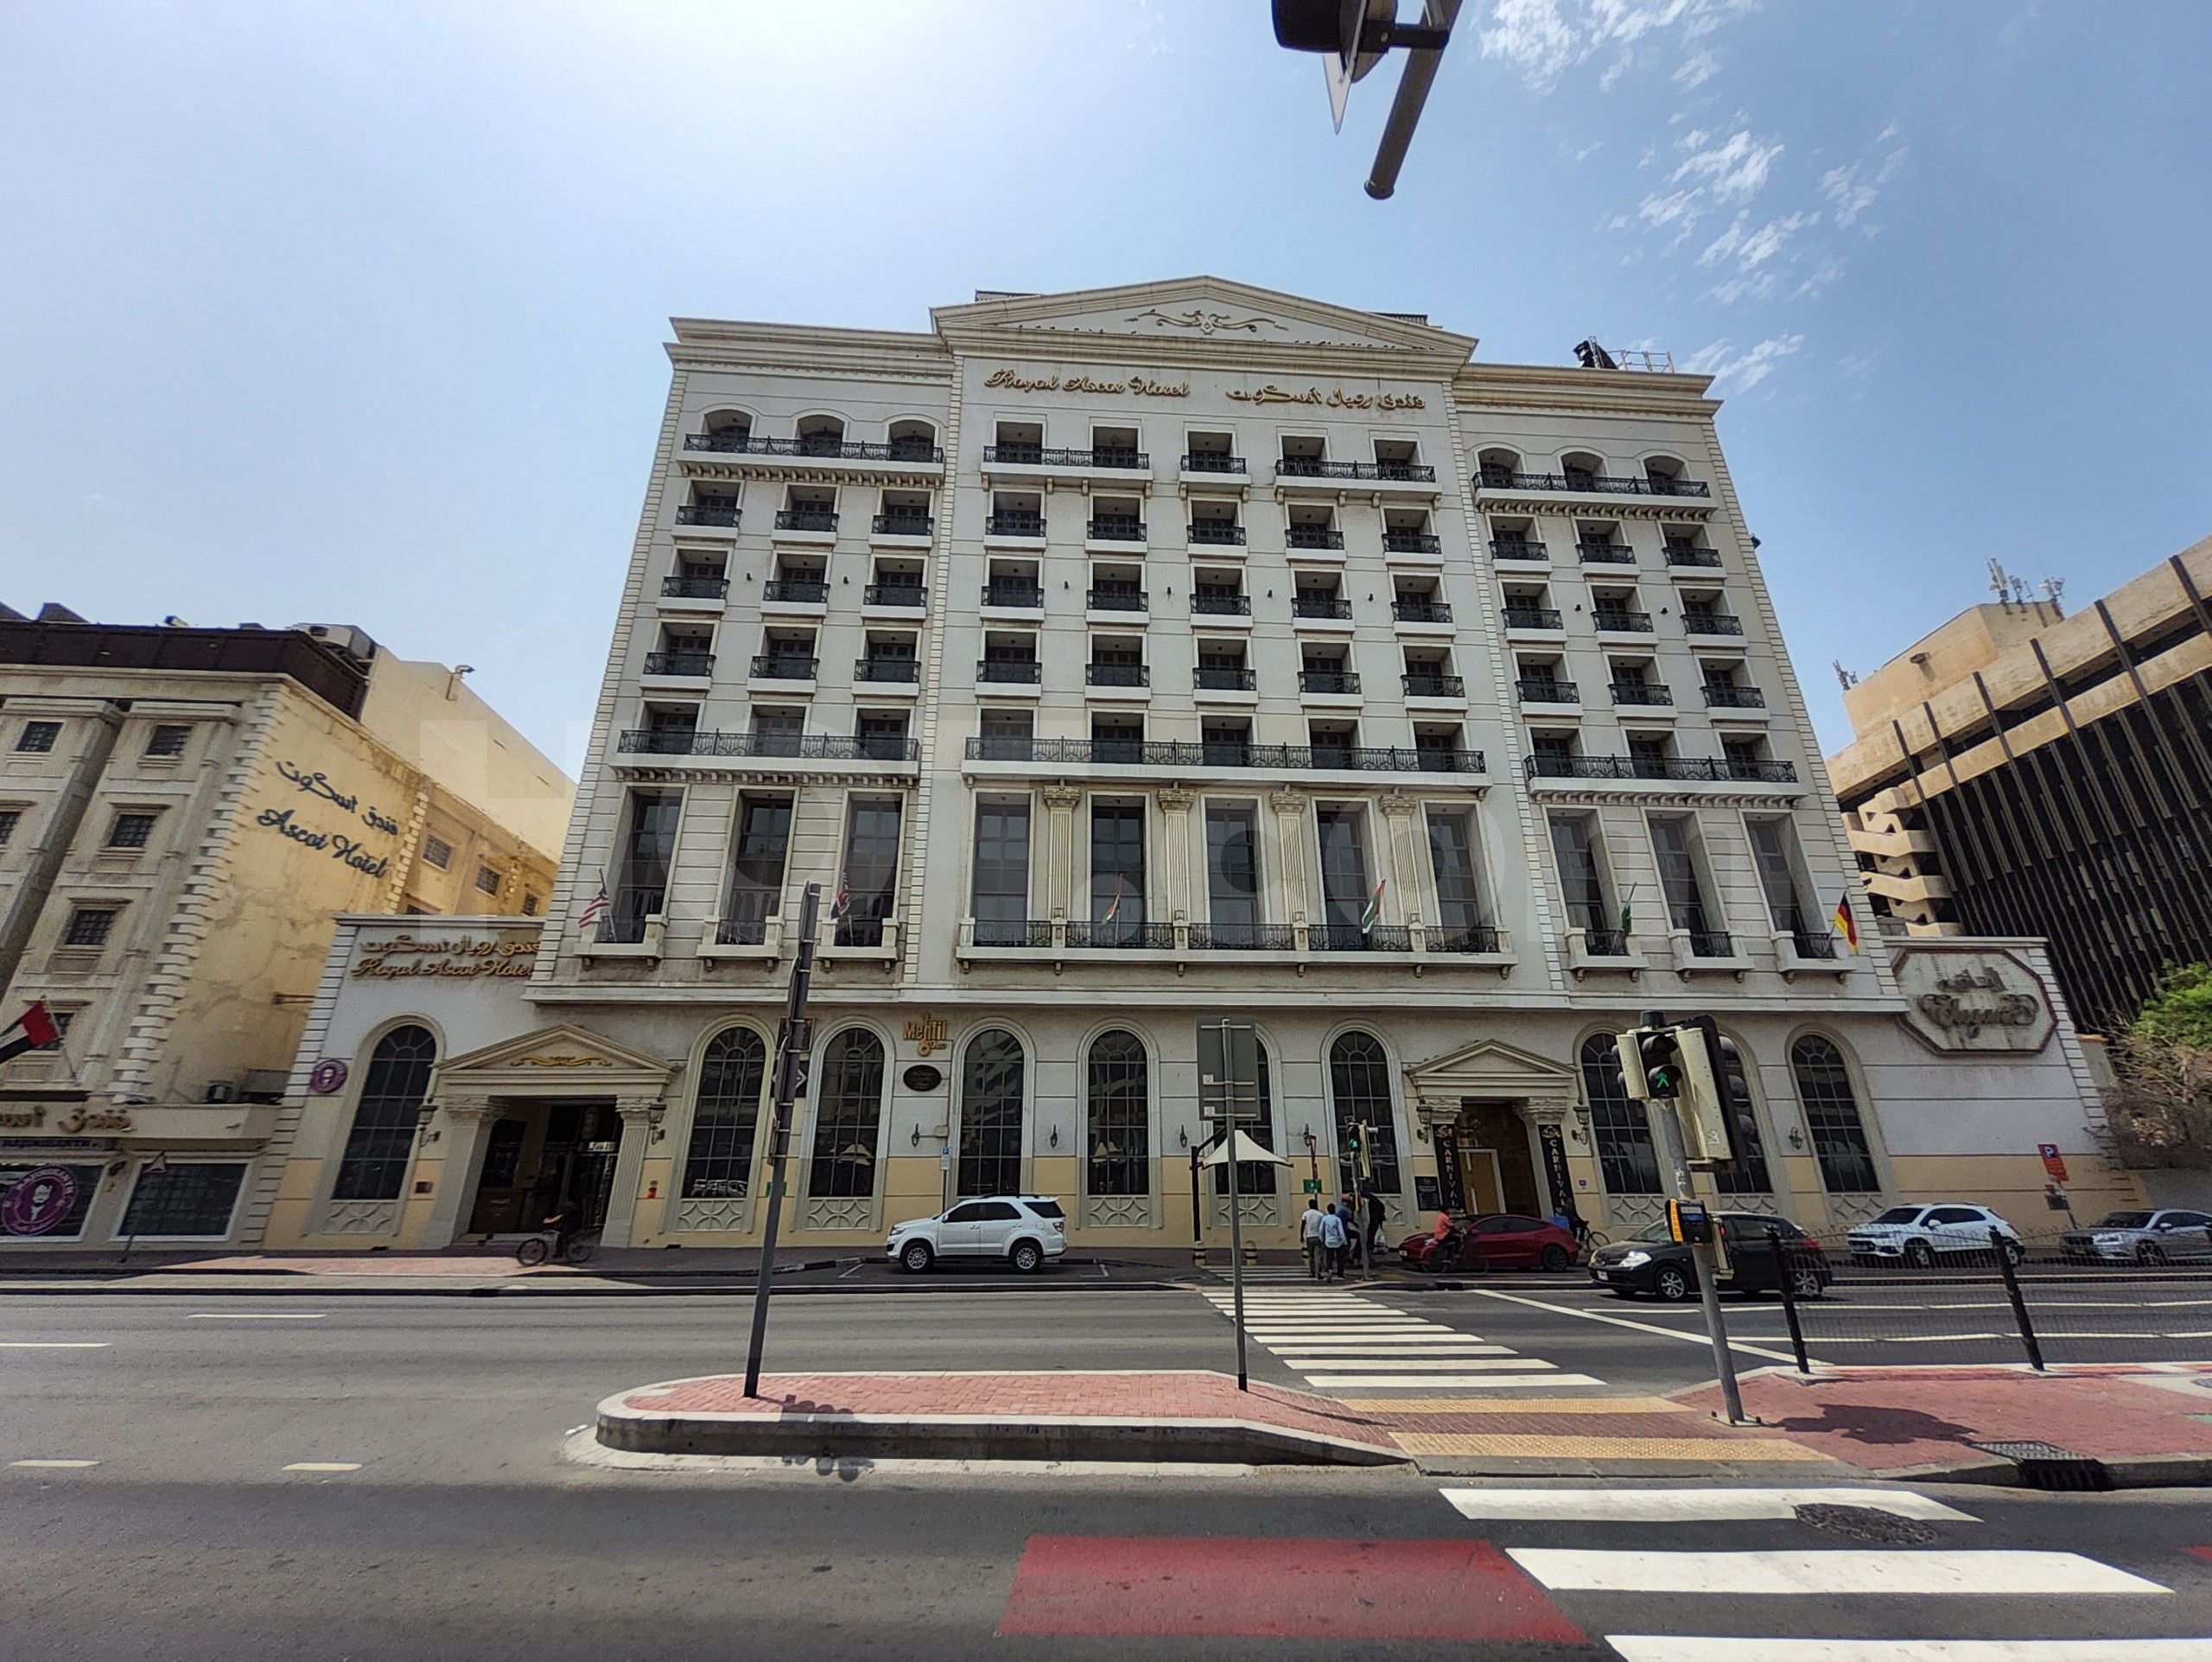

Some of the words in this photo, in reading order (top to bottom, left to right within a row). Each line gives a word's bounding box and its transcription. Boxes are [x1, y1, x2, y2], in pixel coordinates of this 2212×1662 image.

[984, 369, 1058, 392] Royal
[1063, 375, 1125, 393] Ascot
[1128, 376, 1191, 397] Hotel
[256, 808, 328, 850] Ascot
[332, 834, 389, 878] Hotel
[351, 958, 418, 980] Royal
[419, 958, 481, 977] Ascot
[1442, 1140, 1460, 1207] CARNIVAL
[1549, 1139, 1567, 1207] CARNIVAL
[2044, 1146, 2054, 1158] P
